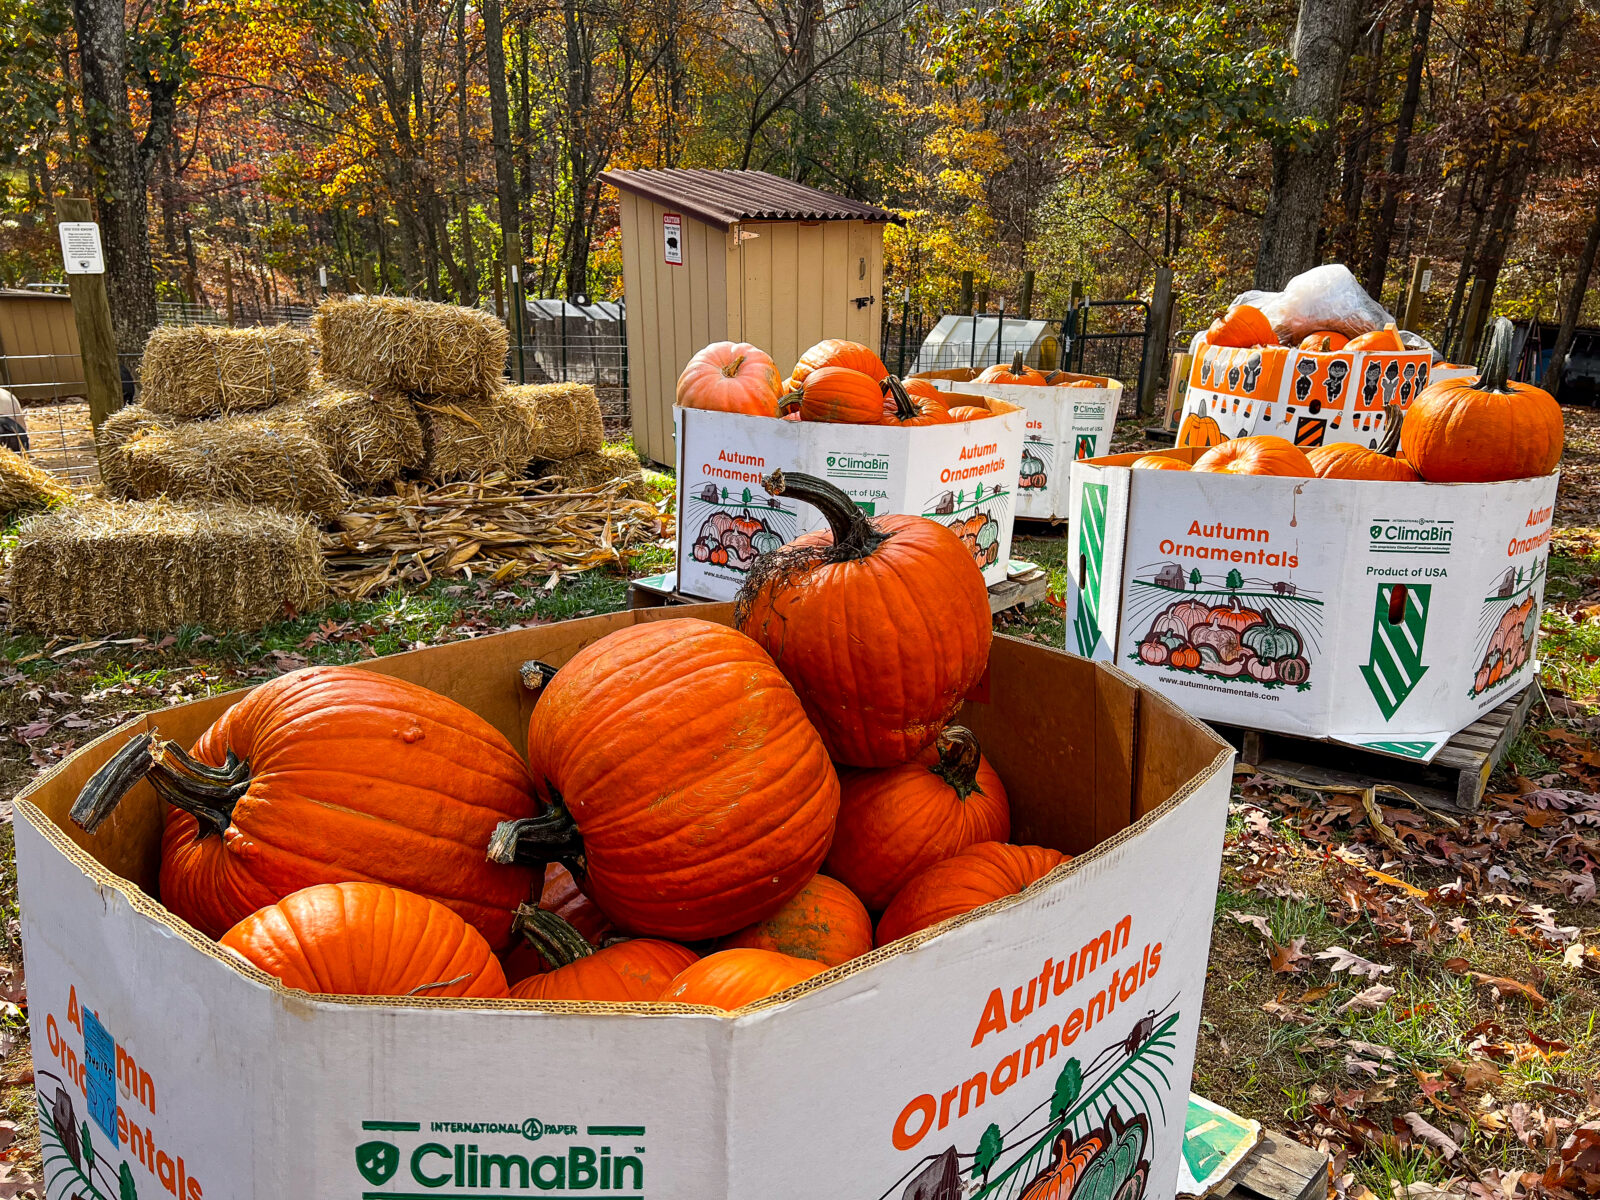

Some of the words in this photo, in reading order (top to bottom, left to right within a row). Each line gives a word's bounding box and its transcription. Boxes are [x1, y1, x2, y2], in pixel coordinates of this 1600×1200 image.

[718, 449, 766, 467] Autumn
[959, 442, 998, 461] Autumn
[838, 456, 889, 470] ClimaBin
[940, 457, 1006, 483] Ornamentals
[702, 463, 763, 485] Ornament
[869, 489, 888, 498] USA
[1187, 520, 1270, 543] Autumn
[1385, 525, 1453, 542] ClimaBin
[1159, 539, 1300, 569] Ornamentals
[1366, 566, 1408, 577] Product
[1411, 567, 1423, 577] of
[1425, 567, 1448, 578] USA
[1158, 675, 1280, 702] www.autumnornamentals.com
[970, 914, 1132, 1048] Autumn
[891, 941, 1163, 1151] Ornamentals
[430, 1121, 522, 1135] INTERNATIONAL
[544, 1123, 578, 1136] PAPER
